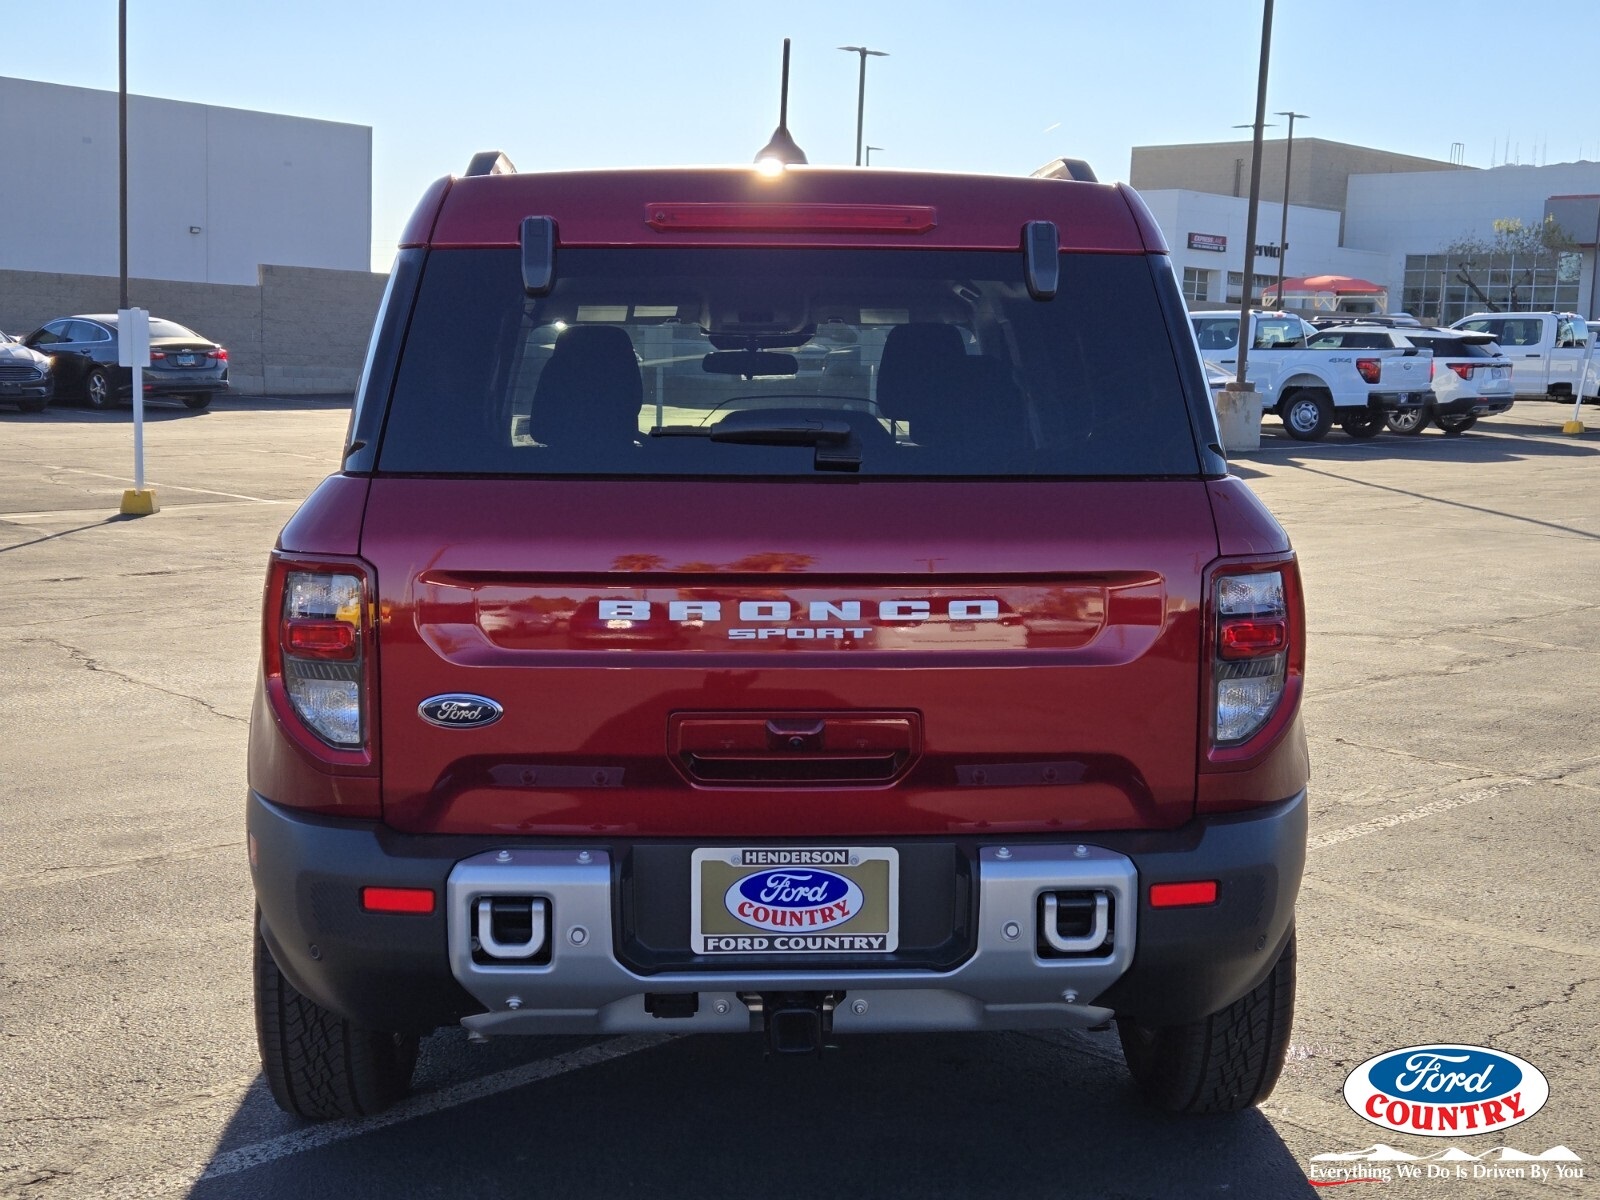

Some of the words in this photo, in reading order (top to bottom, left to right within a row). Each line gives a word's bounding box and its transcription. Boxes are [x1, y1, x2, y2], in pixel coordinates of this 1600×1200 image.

[598, 600, 999, 621] BRONCO
[728, 628, 872, 640] SPORT
[437, 701, 482, 720] Ford
[745, 851, 846, 864] HENDERSON
[760, 873, 829, 903] Ford
[738, 900, 850, 927] COUNTRY
[707, 937, 769, 951] FORD
[774, 937, 884, 950] COUNTRY
